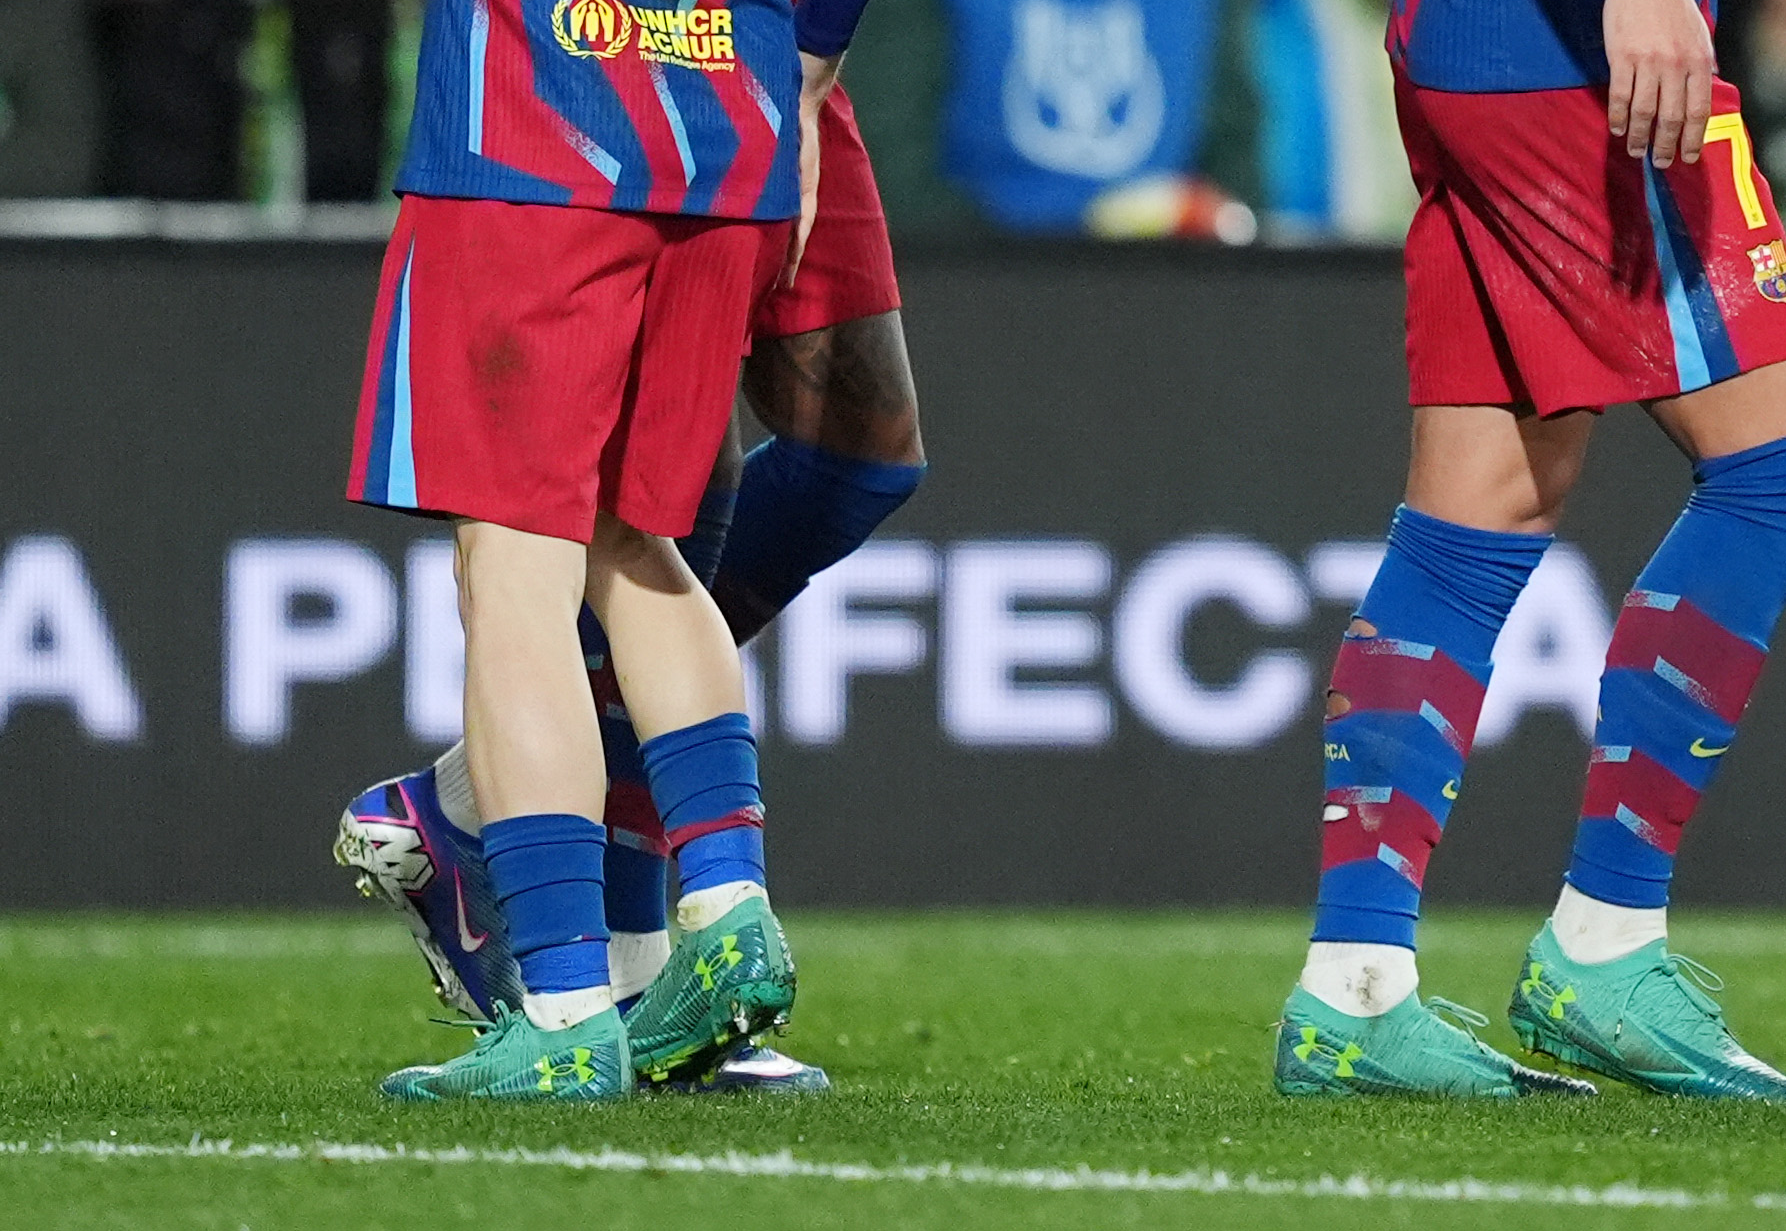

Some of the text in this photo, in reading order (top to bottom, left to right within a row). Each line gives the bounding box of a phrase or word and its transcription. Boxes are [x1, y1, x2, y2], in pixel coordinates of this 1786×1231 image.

[628, 4, 733, 35] UNHCR
[637, 27, 735, 60] ACNUR
[1703, 112, 1767, 230] 7
